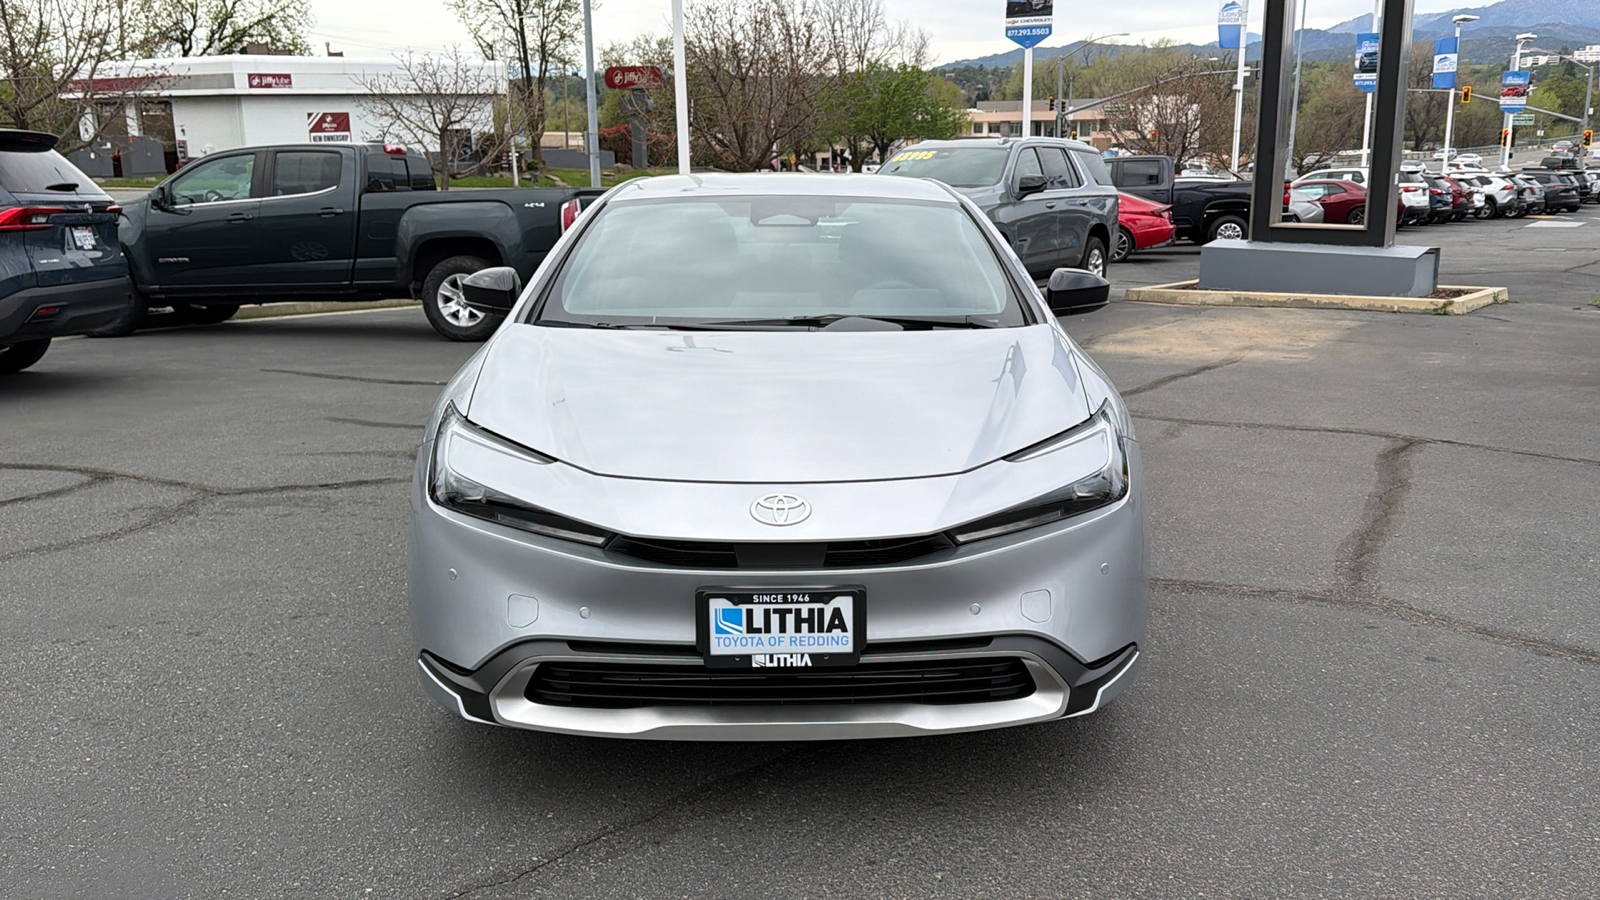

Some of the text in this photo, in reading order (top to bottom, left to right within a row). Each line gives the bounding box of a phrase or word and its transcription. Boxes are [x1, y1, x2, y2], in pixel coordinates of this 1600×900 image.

[1007, 28, 1049, 36] 877.293.5503
[752, 594, 810, 603] SINCE 1946
[746, 607, 848, 634] LITHIA
[714, 635, 849, 647] TOYOTA OF REDDING
[765, 653, 812, 667] LITHIA
